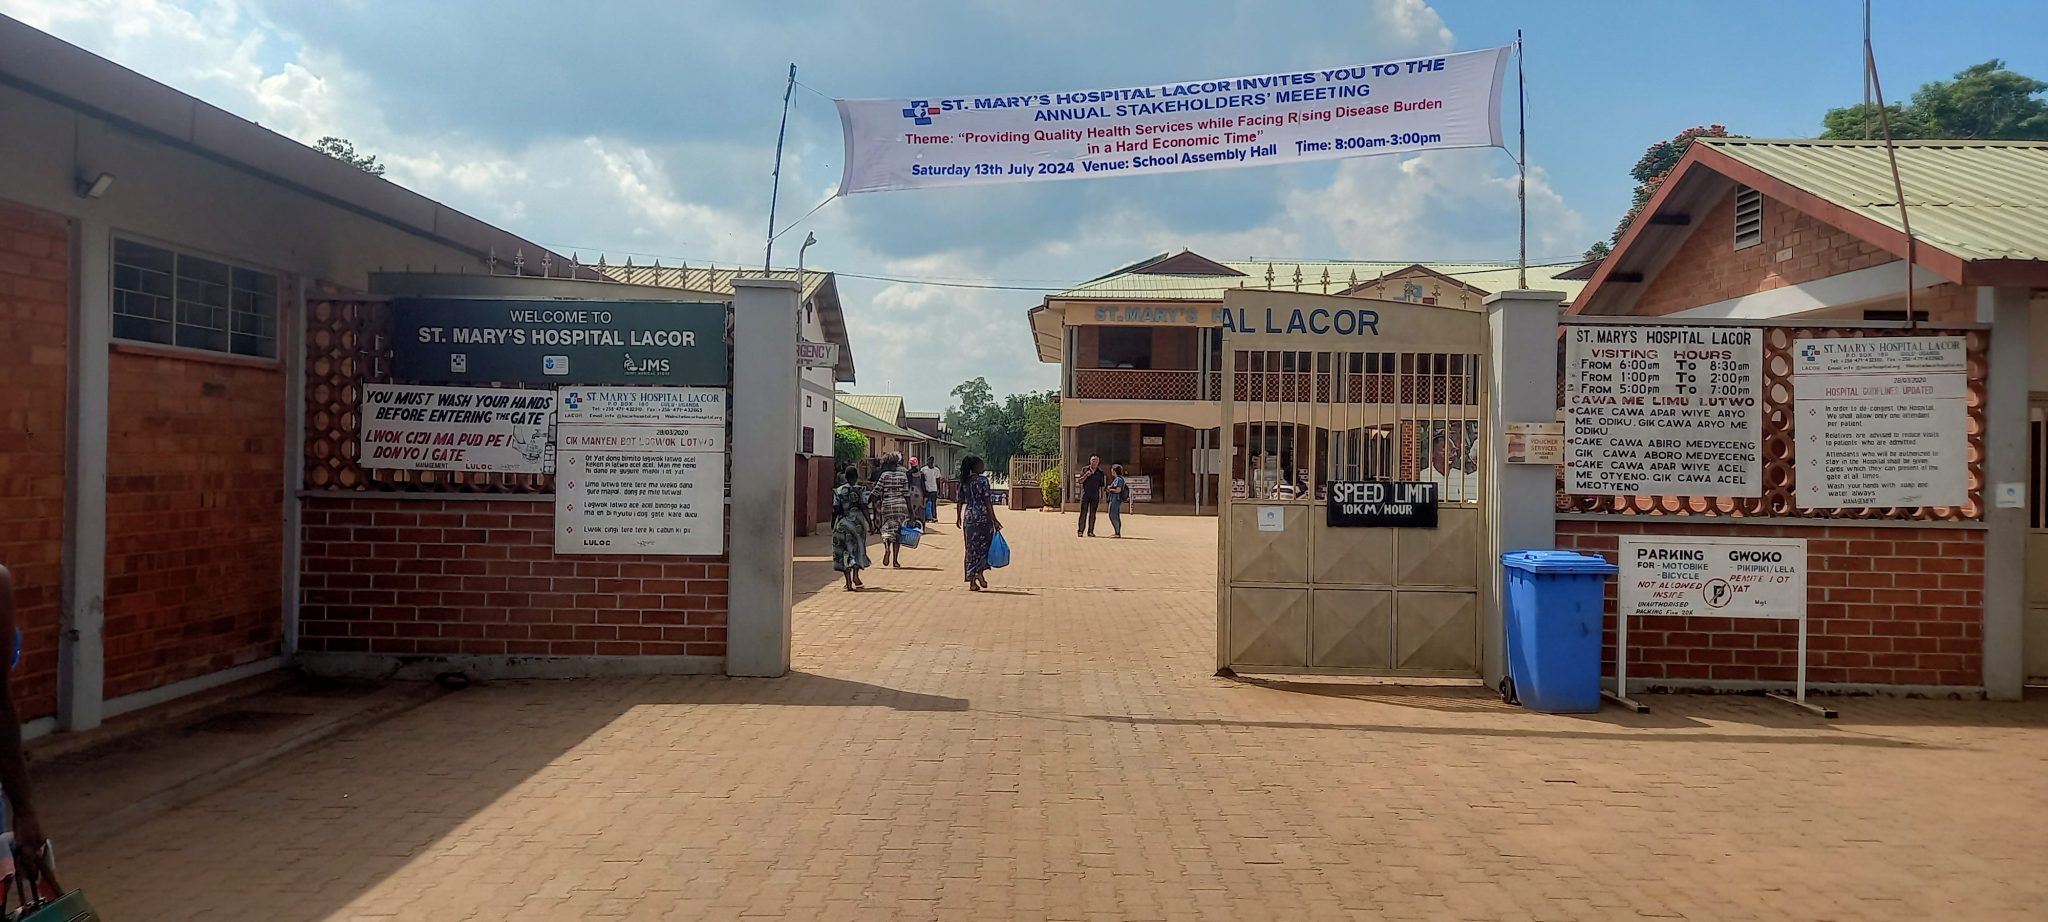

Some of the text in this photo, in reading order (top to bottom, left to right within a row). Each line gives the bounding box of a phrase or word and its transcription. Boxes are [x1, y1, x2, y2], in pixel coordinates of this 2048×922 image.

[941, 58, 1446, 111] ST. MARY'S HOSPITAL LACOR INVITES YOU TO THE
[1034, 84, 1371, 122] ANNUAL STAKEHOLDERS' MEEETING
[905, 99, 1443, 146] Theme: "Providing Quality Health Services while Facing Rsing Disease Burden
[1087, 130, 1265, 155] in a Hard Economic Time"
[911, 131, 1442, 178] Saturday 13th July 2024 Venue: School Assembly Hall Time: 8:00am-3:00pm
[510, 310, 612, 324] WELCOME TO
[1265, 308, 1380, 336] LACOR
[418, 327, 696, 347] ST. MARY'S HOSPITAL LACOR
[1576, 330, 1752, 346] ST. MARY'S HOSPITAL LACOR
[1879, 341, 1924, 352] HOSPITAL
[1591, 349, 1733, 360] VISITING HOURS
[639, 359, 670, 372] JMS
[1581, 359, 1612, 370] FROM
[1619, 359, 1660, 371] 6:00am
[1709, 361, 1750, 372] 8:30am
[1581, 371, 1612, 382] FROM
[1621, 371, 1660, 384] 1:00pm
[1710, 372, 1750, 385] 2:00pm
[1581, 383, 1612, 394] FROM
[1619, 383, 1660, 396] 5:00pm
[1710, 385, 1750, 397] 7:00pm
[1825, 387, 1859, 397] HOSPITAL
[366, 390, 554, 410] YOU MUST WASH YOUR HANDS
[640, 392, 685, 402] HOSPITAL
[687, 393, 719, 403] LACOR
[1572, 395, 1617, 405] CAWA
[1621, 396, 1645, 405] ME
[1652, 396, 1690, 406] LIMU
[375, 407, 545, 425] BEFORE ENTERING THE GATE
[1575, 406, 1746, 418] CAKE CAWA APAR WIYE ARYO
[1575, 417, 1592, 426] ME
[1638, 418, 1656, 427] GIK
[1657, 419, 1693, 428] CAWA
[1696, 420, 1726, 429] ARYO
[1730, 421, 1748, 430] ME
[1575, 426, 1609, 436] ODIKU
[365, 429, 513, 448] LWOK MA PUD PE I
[565, 436, 618, 446] CIK MANYEN
[1574, 437, 1756, 451] CAKE CAWA ABIRO MEDYECENG
[373, 445, 421, 460] DONYO
[422, 447, 430, 461] I
[1575, 448, 1756, 462] GIK CAWA ABORO MEDYECENG
[1575, 460, 1746, 473] CAKE CAWA APAR WIYE ACEL
[1575, 470, 1593, 479] ME
[1652, 473, 1672, 482] GIK
[1677, 474, 1712, 483] CAWA
[1717, 475, 1747, 485] ACEL
[1333, 482, 1433, 504] SPEED LIMIT
[1851, 489, 1876, 497] always
[1342, 504, 1413, 516] 10KM/HOUR
[1637, 548, 1783, 563] PARKING GWOKO
[1637, 561, 1655, 569] FOR
[1637, 580, 1703, 590] NOT ALLOWED
[1732, 584, 1751, 593] YAT
